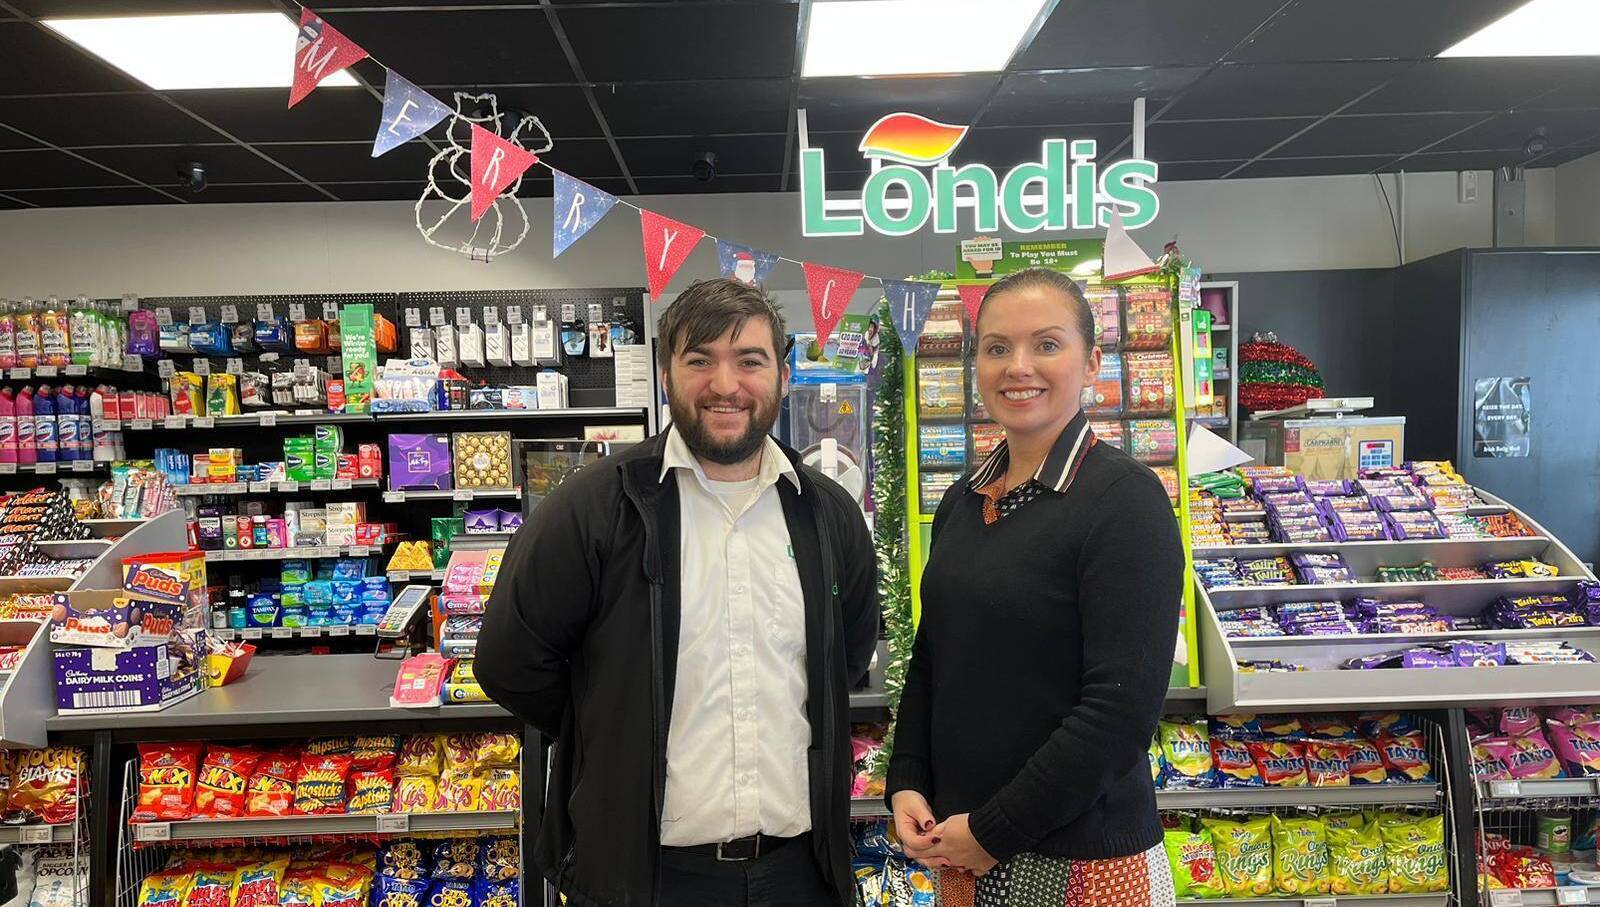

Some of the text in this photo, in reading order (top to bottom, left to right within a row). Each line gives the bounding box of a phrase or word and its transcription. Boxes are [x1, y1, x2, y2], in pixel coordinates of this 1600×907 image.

[300, 37, 679, 272] M E R R Y
[799, 138, 1160, 238] Londis
[1020, 243, 1067, 252] REMEMBER
[821, 279, 917, 332] C H
[65, 674, 144, 685] DAIRY MILK COINS
[1171, 740, 1210, 754] TAYTO
[1386, 747, 1428, 761] TAYTO
[1348, 751, 1381, 763] TAYT
[1510, 749, 1554, 768] TAYTO
[19, 766, 73, 785] GIANTS
[1217, 850, 1270, 884] Rings
